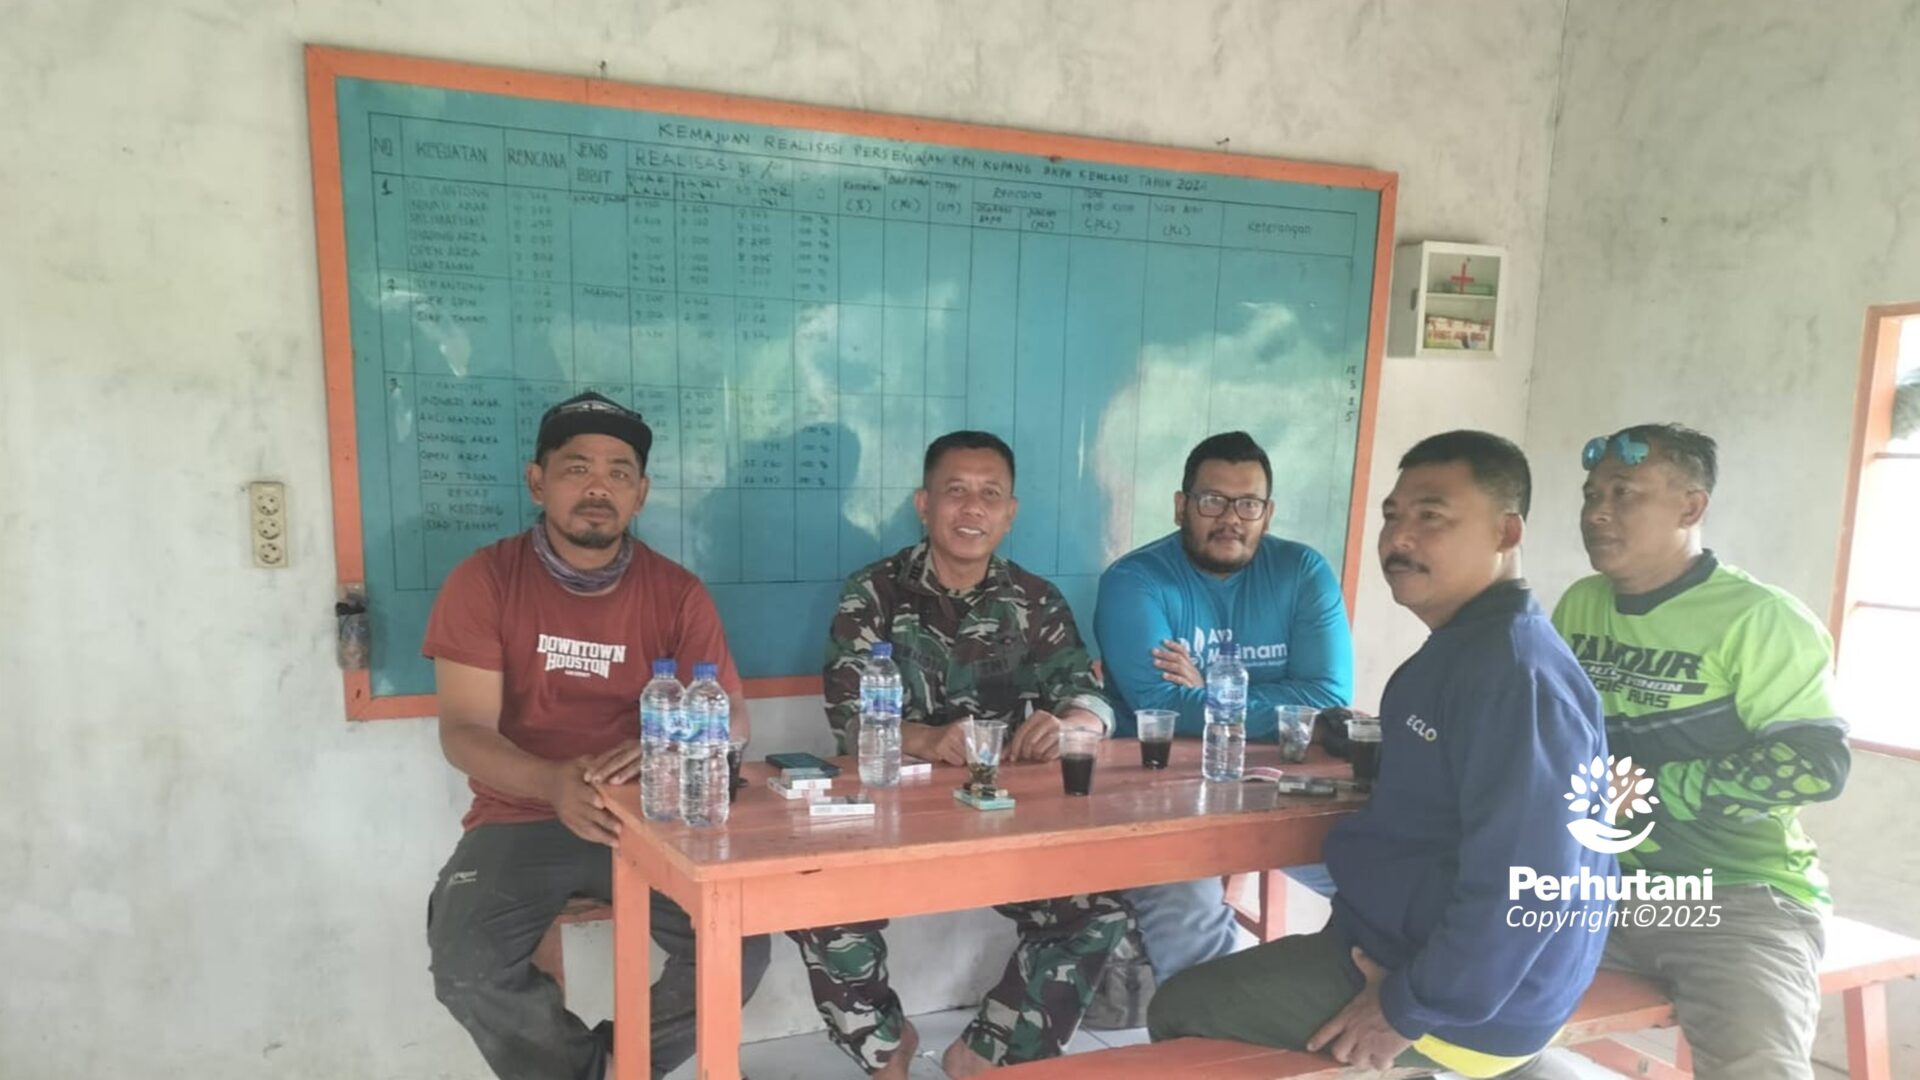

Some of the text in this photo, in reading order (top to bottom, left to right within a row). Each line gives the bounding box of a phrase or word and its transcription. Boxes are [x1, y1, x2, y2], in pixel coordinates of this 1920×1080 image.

[416, 141, 488, 165] KEGIATAN
[507, 147, 568, 169] RENCANA
[658, 122, 750, 145] KEMAJUAN
[764, 134, 844, 156] REALISASI
[983, 159, 1032, 175] KUPANG
[380, 178, 393, 196] 1
[576, 166, 614, 185] BIBIT
[1247, 221, 1313, 241] Keterangan
[536, 633, 627, 663] DOWNTOWN
[544, 652, 611, 679] HOUSTON
[1405, 714, 1438, 742] ECLO
